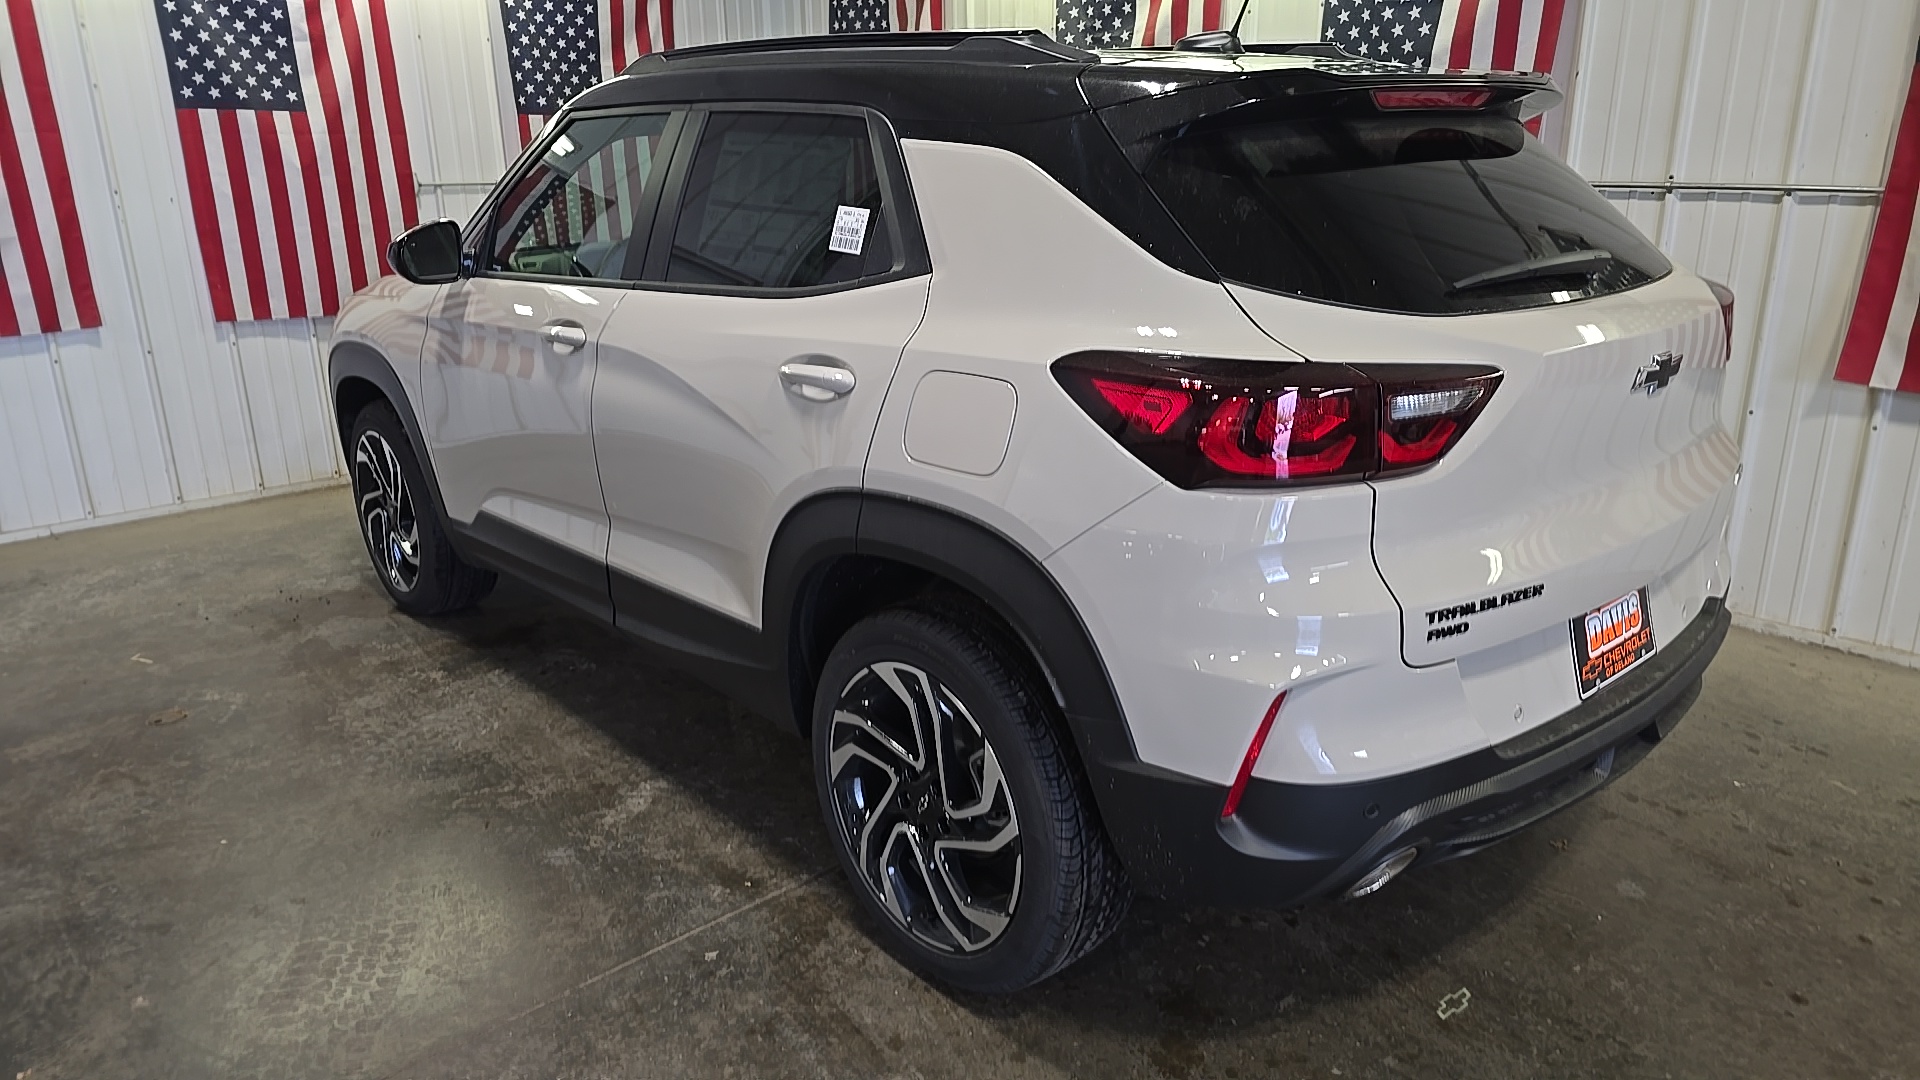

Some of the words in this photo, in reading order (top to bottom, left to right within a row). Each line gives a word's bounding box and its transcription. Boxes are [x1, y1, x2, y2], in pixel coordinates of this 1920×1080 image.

[1425, 583, 1544, 626] TRAILBLAZER
[1586, 592, 1641, 653] DAVIS
[1427, 621, 1470, 643] AWD
[1603, 627, 1651, 666] CHEVROLET
[1605, 667, 1614, 678] OF
[1614, 653, 1635, 674] DELANO
